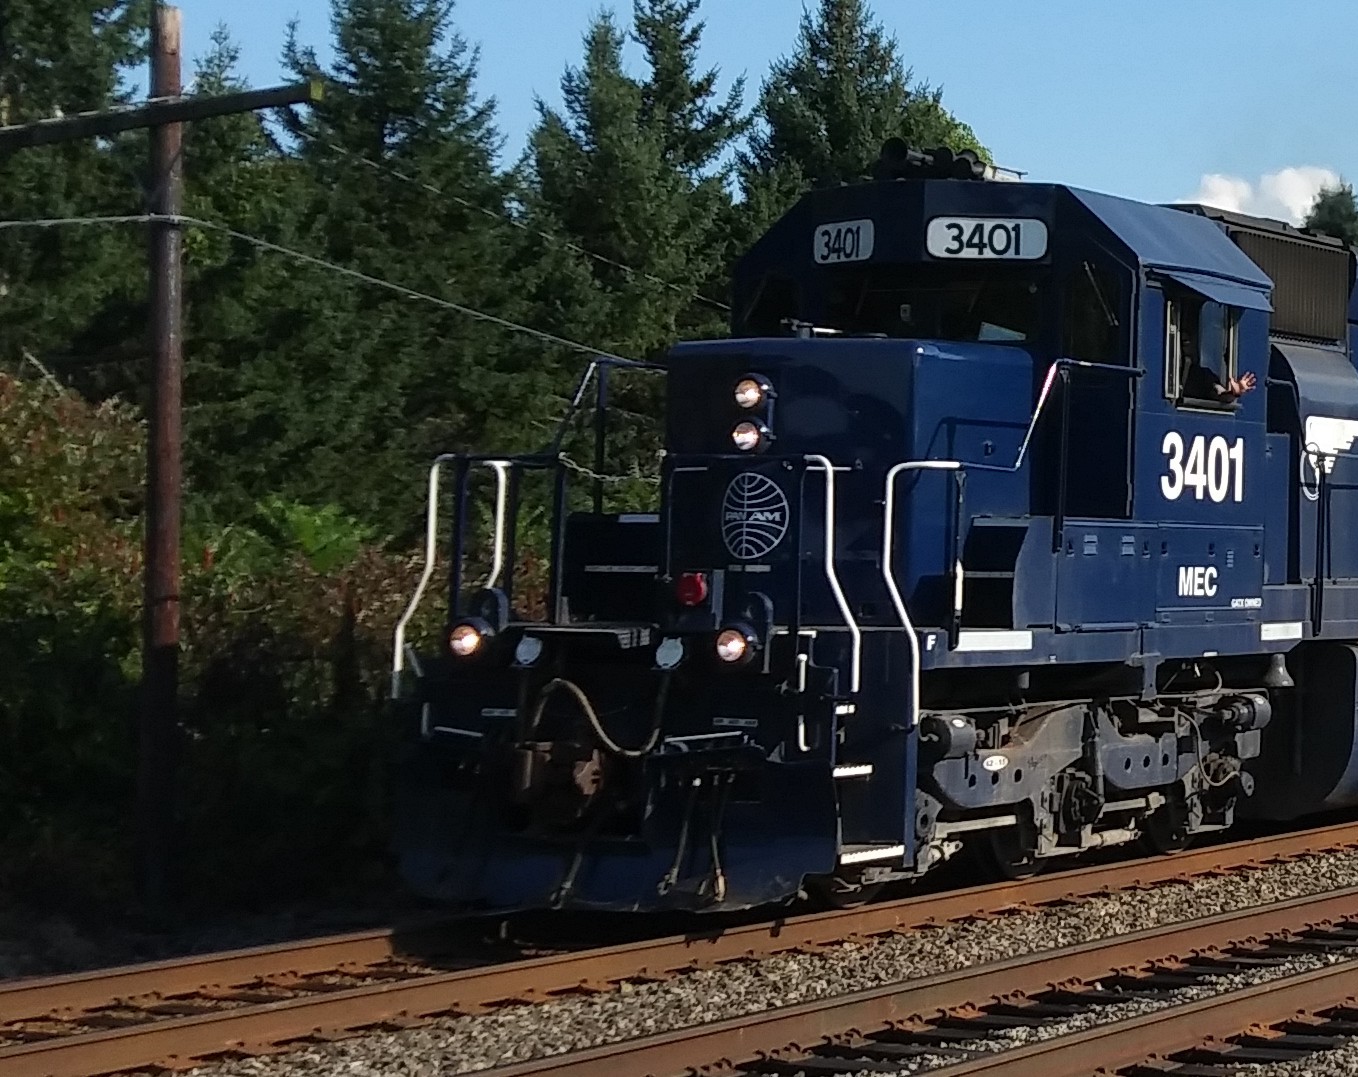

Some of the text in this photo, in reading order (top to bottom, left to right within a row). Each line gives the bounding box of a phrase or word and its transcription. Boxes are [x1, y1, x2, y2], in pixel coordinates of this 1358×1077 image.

[820, 225, 861, 261] 3401
[944, 223, 1021, 256] 3401
[1160, 431, 1244, 503] 3401
[725, 511, 782, 522] PAN AM
[1178, 566, 1218, 597] MEC
[926, 634, 937, 651] F
